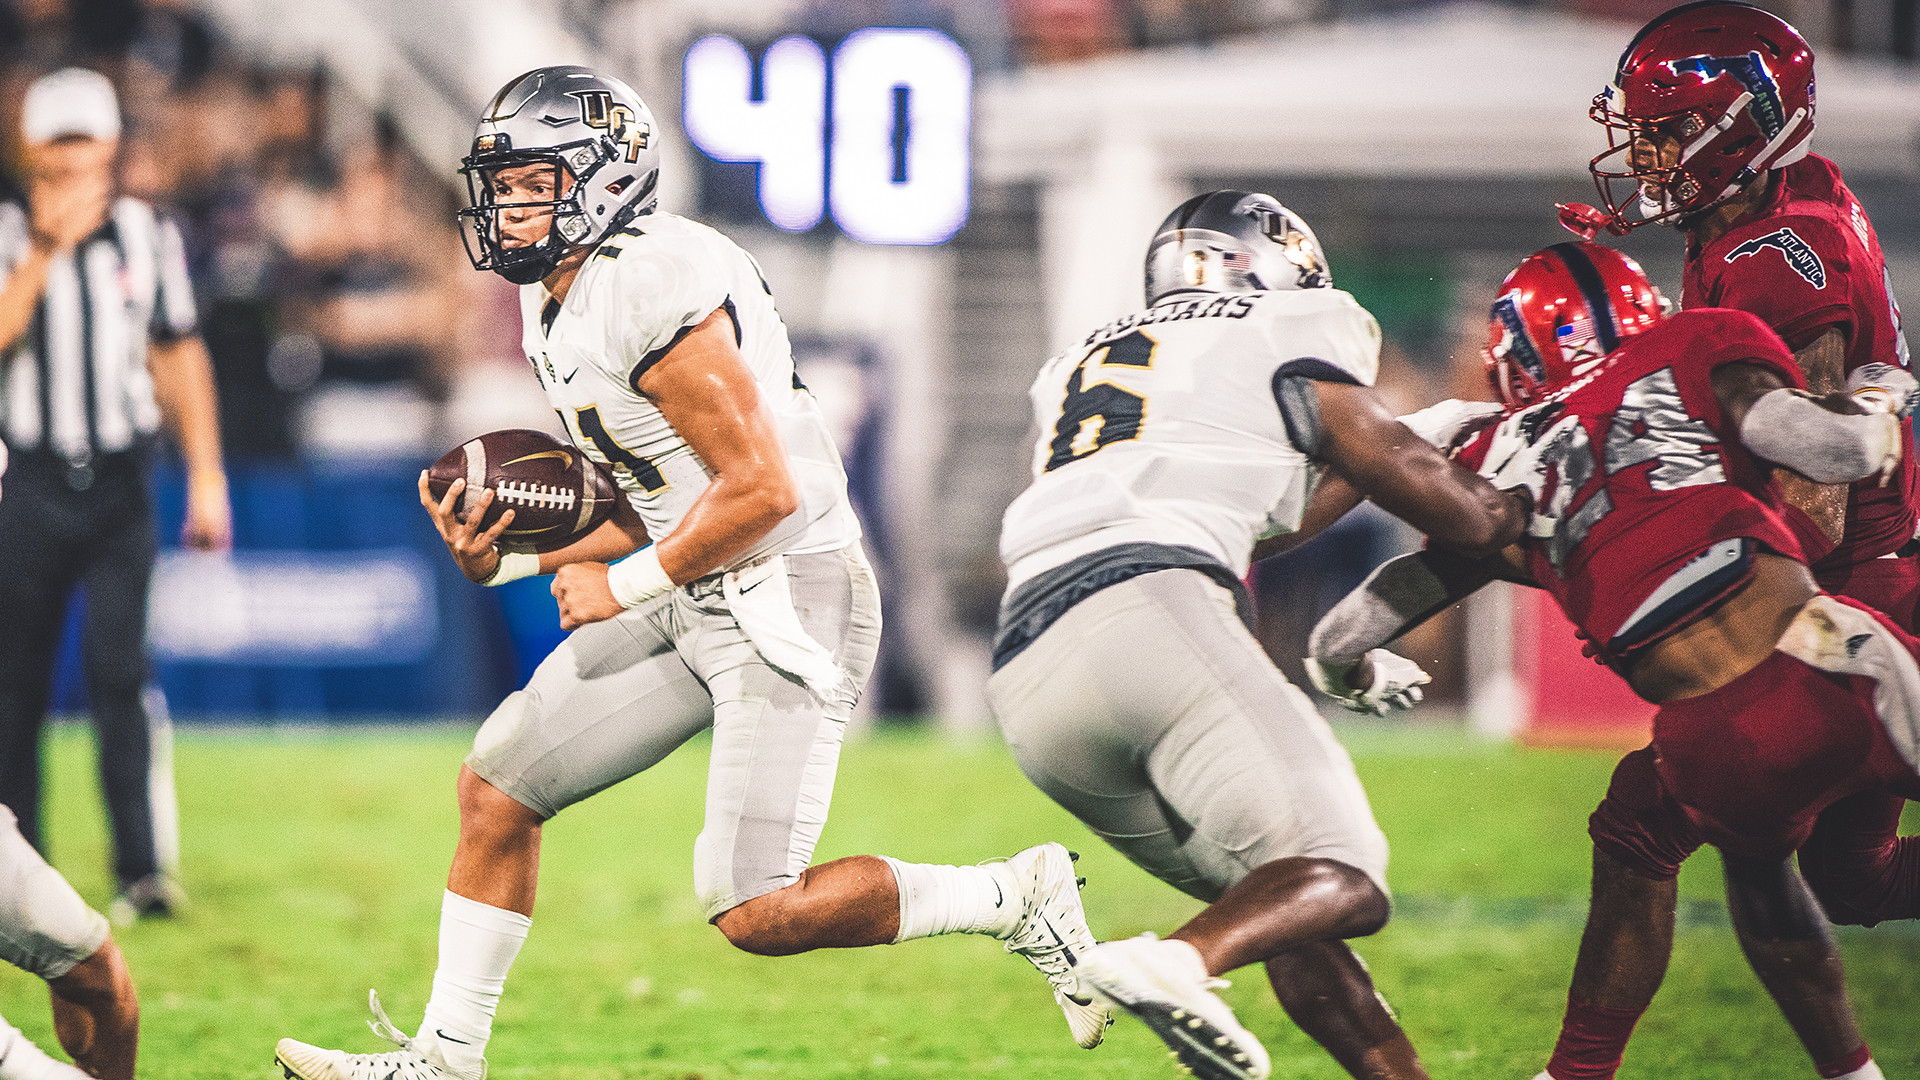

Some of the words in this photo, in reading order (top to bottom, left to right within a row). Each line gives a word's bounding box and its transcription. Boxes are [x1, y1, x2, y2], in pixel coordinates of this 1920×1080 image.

[565, 90, 651, 165] UCF
[682, 26, 973, 246] 40
[1777, 234, 1822, 281] ATLANTIC
[1043, 328, 1160, 474] 6
[554, 403, 671, 497] 1
